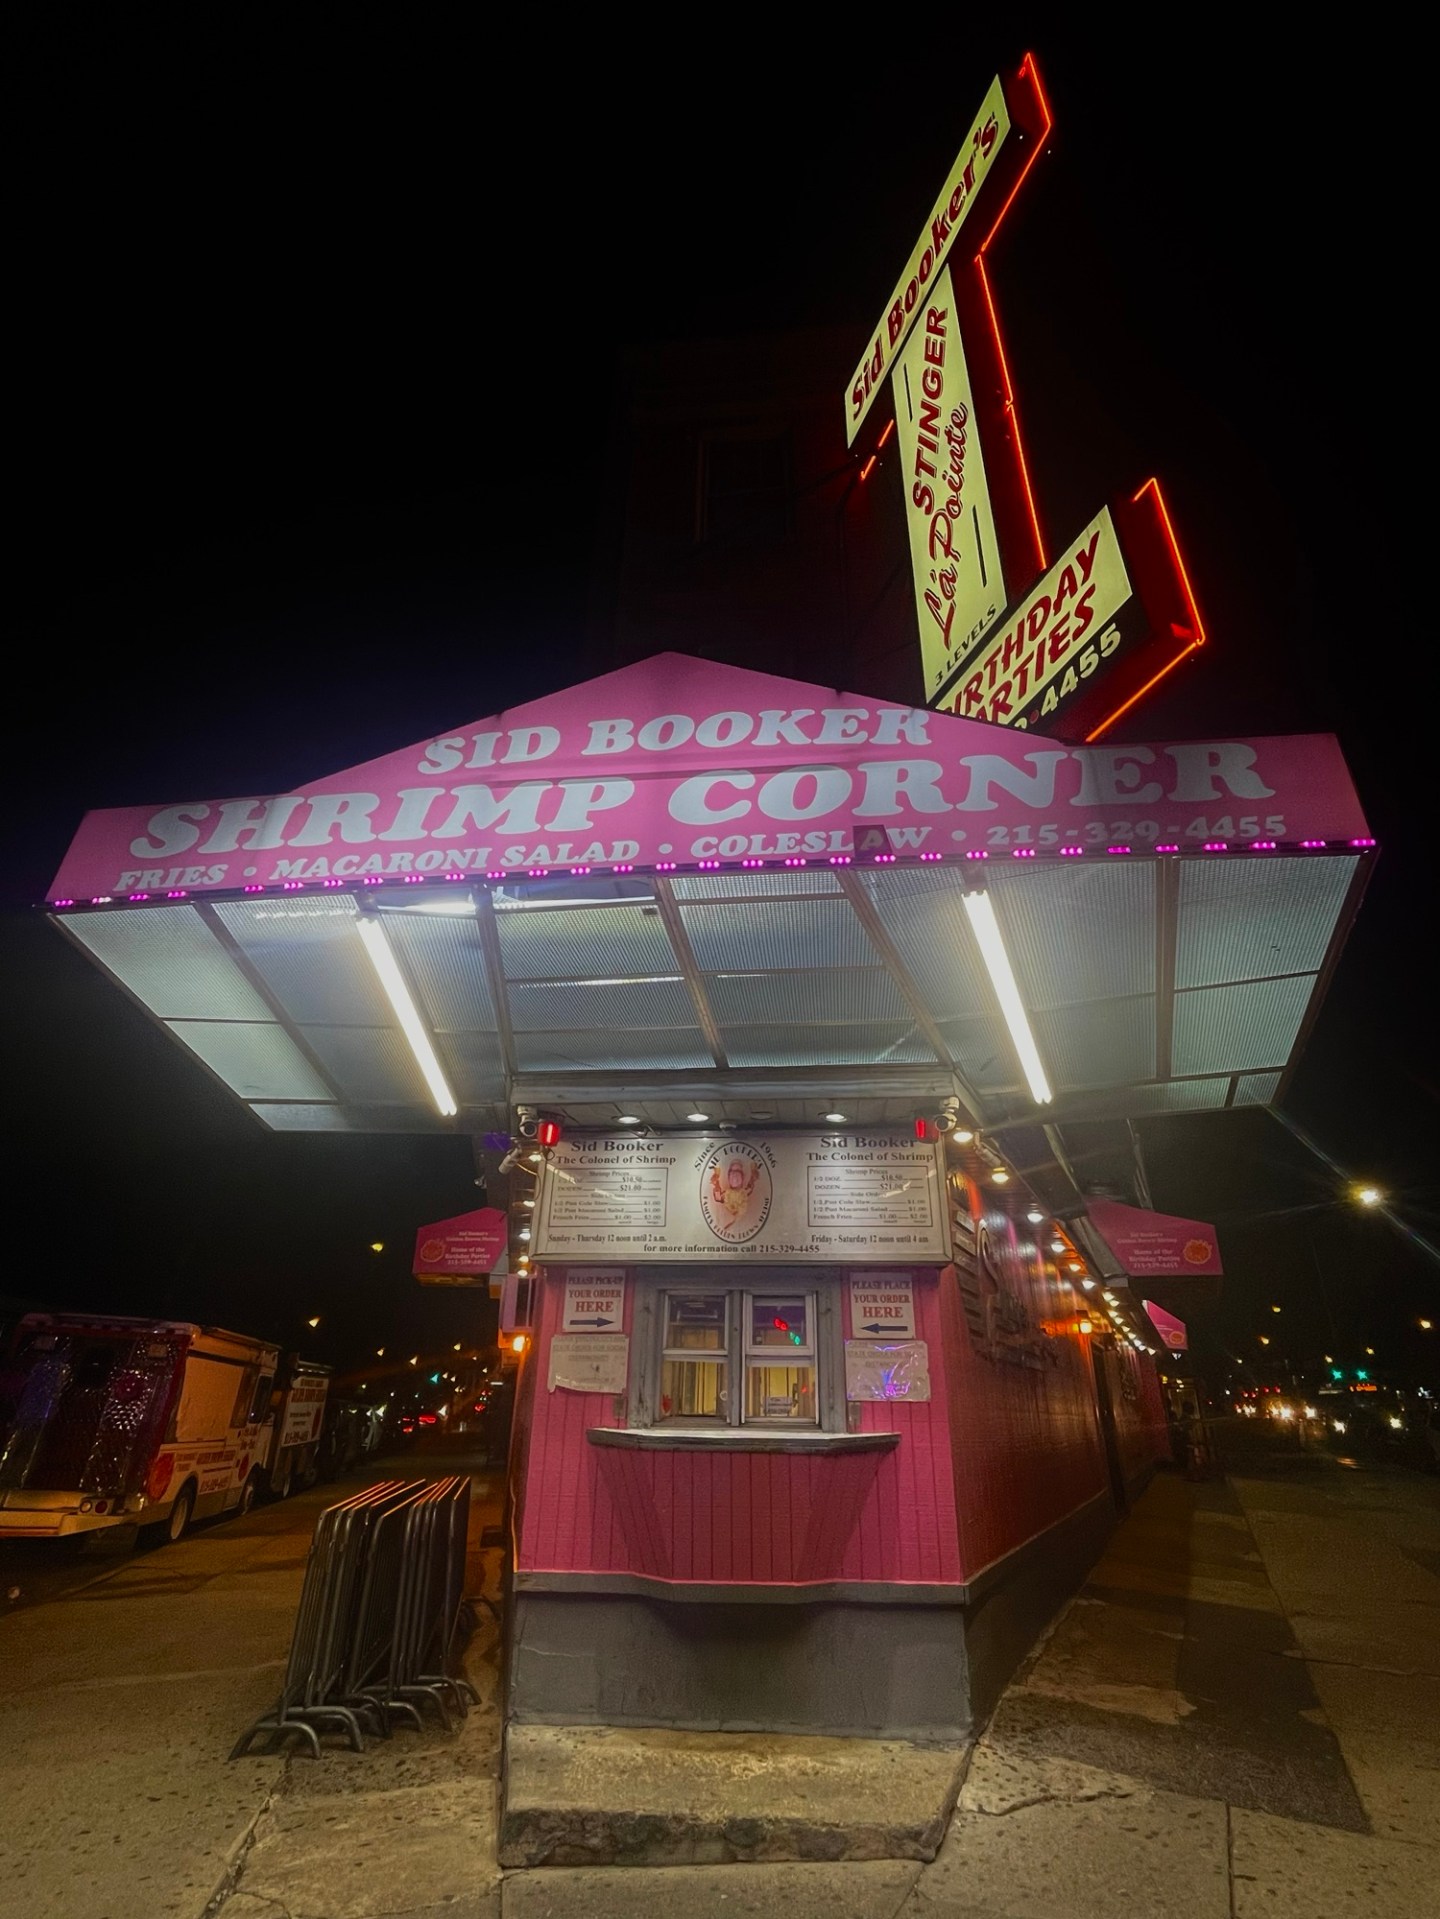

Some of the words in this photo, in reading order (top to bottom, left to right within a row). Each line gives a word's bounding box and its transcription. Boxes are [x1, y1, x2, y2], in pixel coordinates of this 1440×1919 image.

[852, 333, 885, 421] Sid
[886, 112, 1000, 350] Booker's
[911, 306, 948, 517] STINGER
[930, 403, 969, 562] Pointe
[944, 530, 1103, 718] IRTHDAY
[935, 670, 943, 687] 3
[945, 602, 997, 674] LEVELS
[417, 724, 562, 776] SID
[581, 708, 933, 757] BOOKER
[130, 776, 637, 861] SHRIMP
[668, 742, 1278, 827] CORNER
[112, 863, 231, 893] FRIES
[269, 846, 492, 882] MACARONI
[499, 838, 640, 868] SALAD
[690, 825, 933, 859] COLESLAW
[986, 814, 1287, 846] 215-329-4455
[571, 1141, 597, 1152] Sid
[604, 1141, 664, 1152] Booker
[820, 1137, 847, 1148] Sid
[855, 1137, 917, 1148] Booker
[556, 1156, 577, 1164] The
[579, 1156, 619, 1164] Colonel
[622, 1155, 633, 1164] of
[635, 1155, 677, 1166] Shrimp
[694, 1142, 715, 1171] Since
[760, 1141, 778, 1169] 1966
[808, 1152, 828, 1161] The
[831, 1152, 874, 1161] Colonel
[877, 1152, 888, 1161] of
[891, 1152, 934, 1163] Shrimp
[577, 1233, 605, 1243] Thursday
[608, 1233, 614, 1242] 12
[632, 1233, 646, 1242] until
[648, 1233, 653, 1242] 2
[811, 1234, 833, 1244] Friday
[838, 1234, 868, 1244] Saturday
[869, 1234, 877, 1243] 12
[896, 1234, 911, 1243] until
[912, 1234, 917, 1243] 4
[643, 1244, 661, 1254] for
[663, 1246, 681, 1254] more
[684, 1244, 740, 1254] information
[741, 1244, 758, 1254] call
[759, 1244, 820, 1254] 215-329-4455
[568, 1276, 595, 1285] PLEASE
[595, 1276, 624, 1285] PICK-UP
[852, 1280, 883, 1290] PLEASE
[884, 1280, 911, 1290] PLACE
[568, 1289, 592, 1298] YOUR
[593, 1289, 622, 1298] ORDER
[853, 1294, 879, 1304] YOUR
[880, 1294, 910, 1304] ORDER
[574, 1301, 615, 1313] HERE
[862, 1306, 904, 1319] HERE
